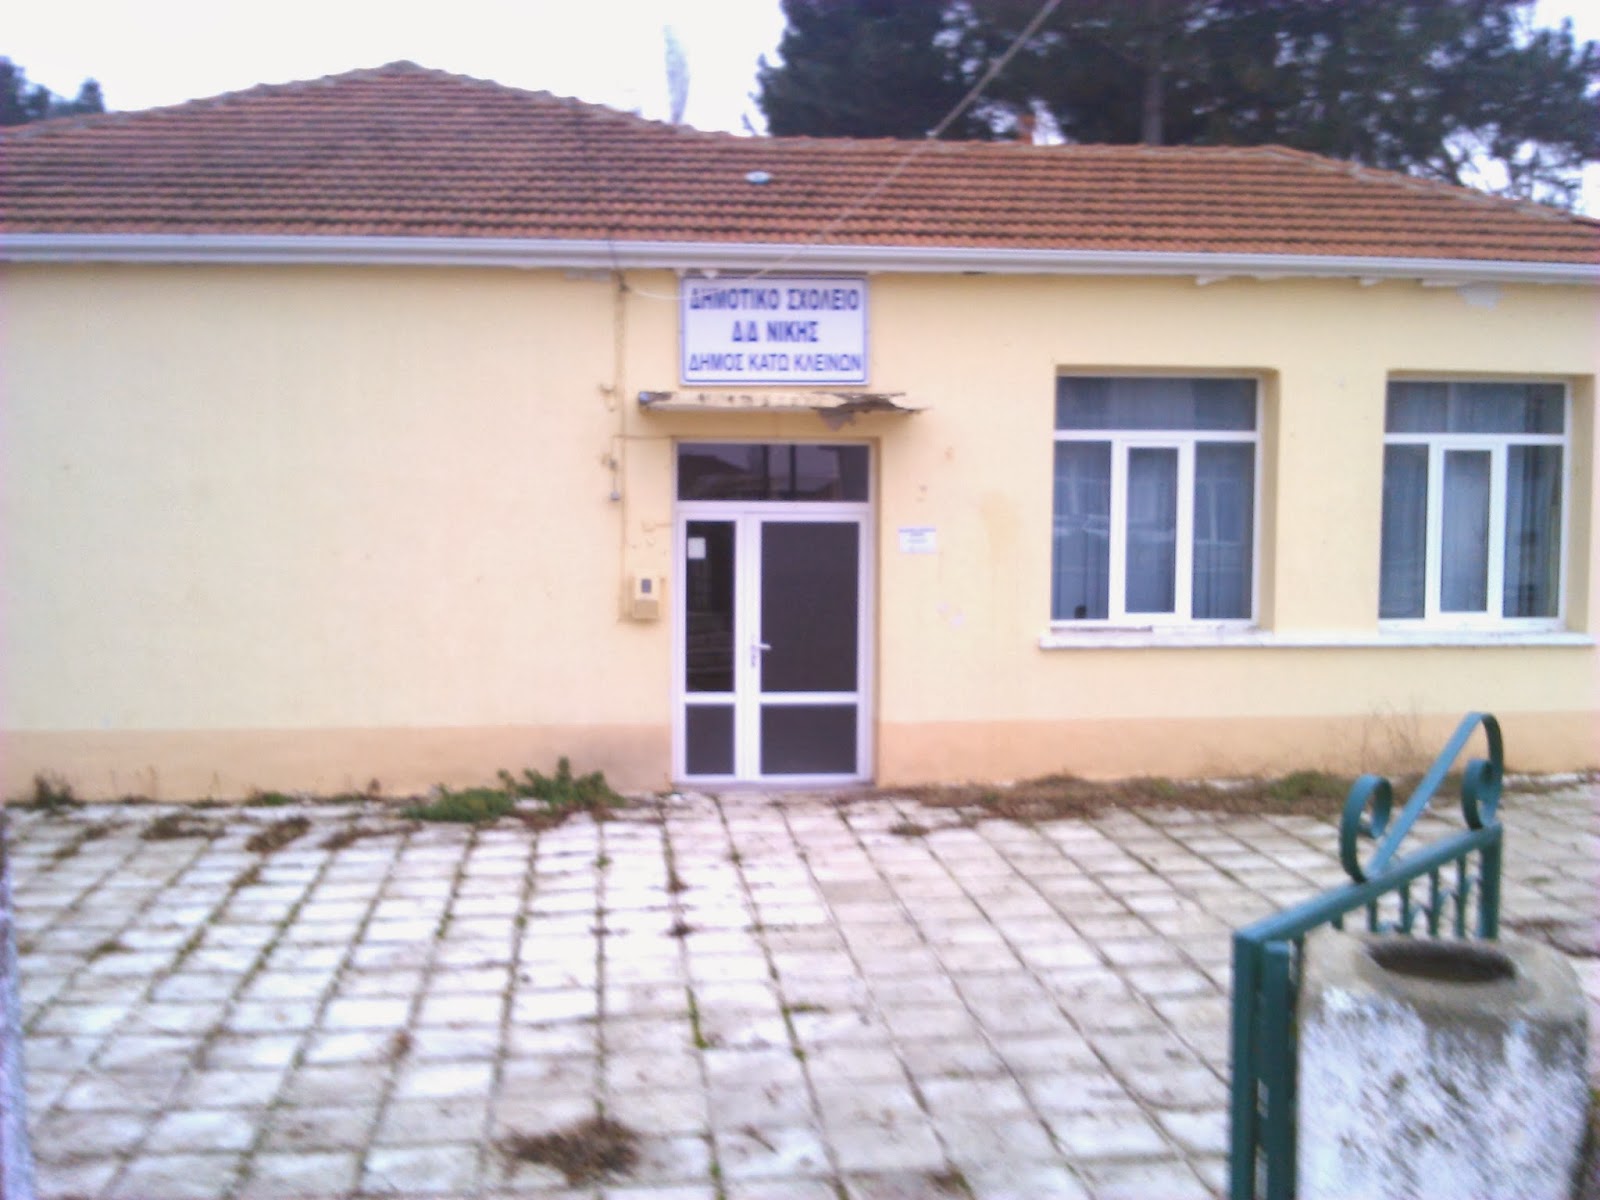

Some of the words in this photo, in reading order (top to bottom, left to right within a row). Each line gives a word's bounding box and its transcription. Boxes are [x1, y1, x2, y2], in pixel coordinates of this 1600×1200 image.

[689, 287, 780, 310] ΔΗΜΟΤΙΚΟ
[787, 288, 859, 310] ΣΧΟΛΕΙΟ
[766, 320, 819, 342] ΝΙΚΗΣ
[689, 353, 744, 371] ΔΗΜΟΣ
[749, 353, 789, 371] ΚΑΤΩ
[794, 353, 862, 371] ΚΛΕΙΝΩΝ
